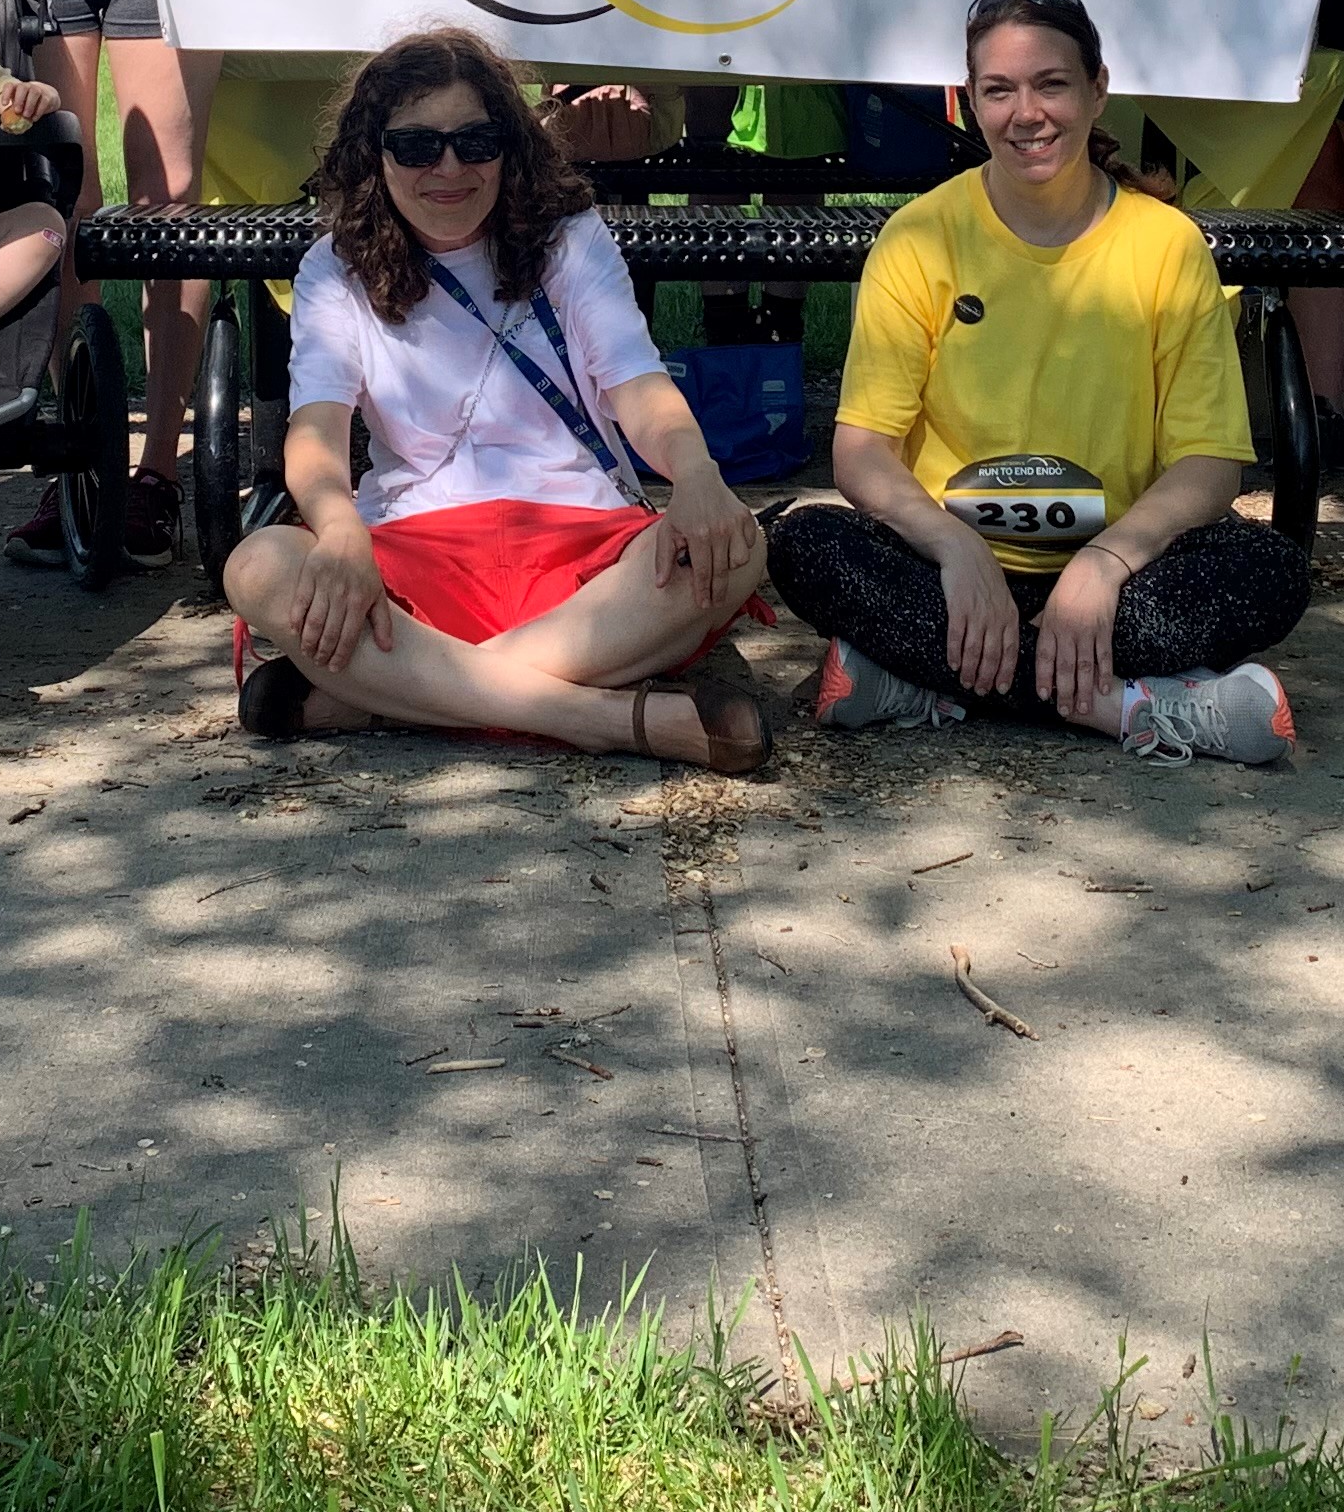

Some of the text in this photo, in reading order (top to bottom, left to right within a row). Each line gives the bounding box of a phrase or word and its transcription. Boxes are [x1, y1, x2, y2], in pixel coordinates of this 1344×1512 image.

[979, 466, 1063, 476] RUN TO END ENDO
[976, 501, 1076, 533] 230
